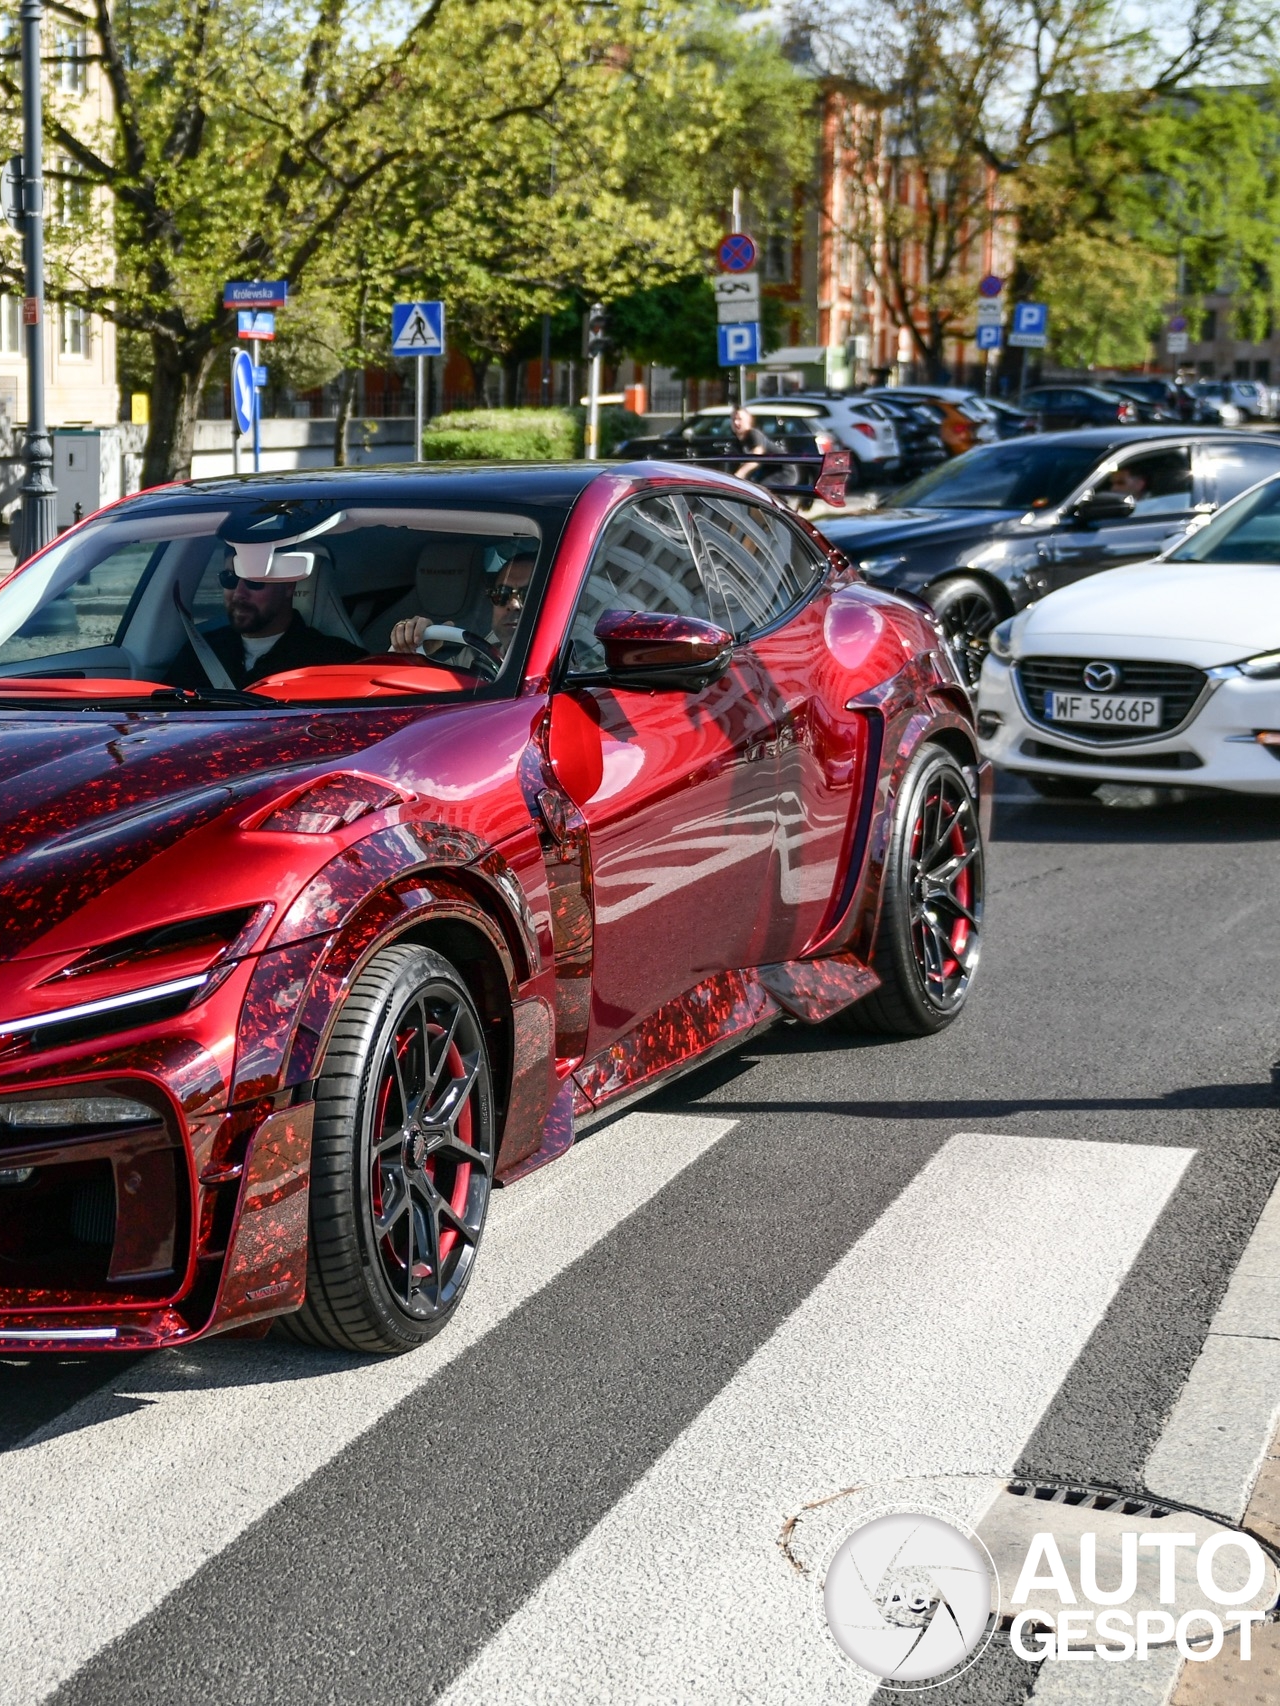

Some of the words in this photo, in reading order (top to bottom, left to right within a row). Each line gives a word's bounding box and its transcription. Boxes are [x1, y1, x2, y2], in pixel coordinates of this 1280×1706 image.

[233, 287, 273, 299] Królewska
[1020, 307, 1040, 331] P
[727, 327, 751, 361] P
[980, 328, 997, 347] P
[1056, 696, 1082, 718] WF
[1090, 699, 1155, 723] 5666P
